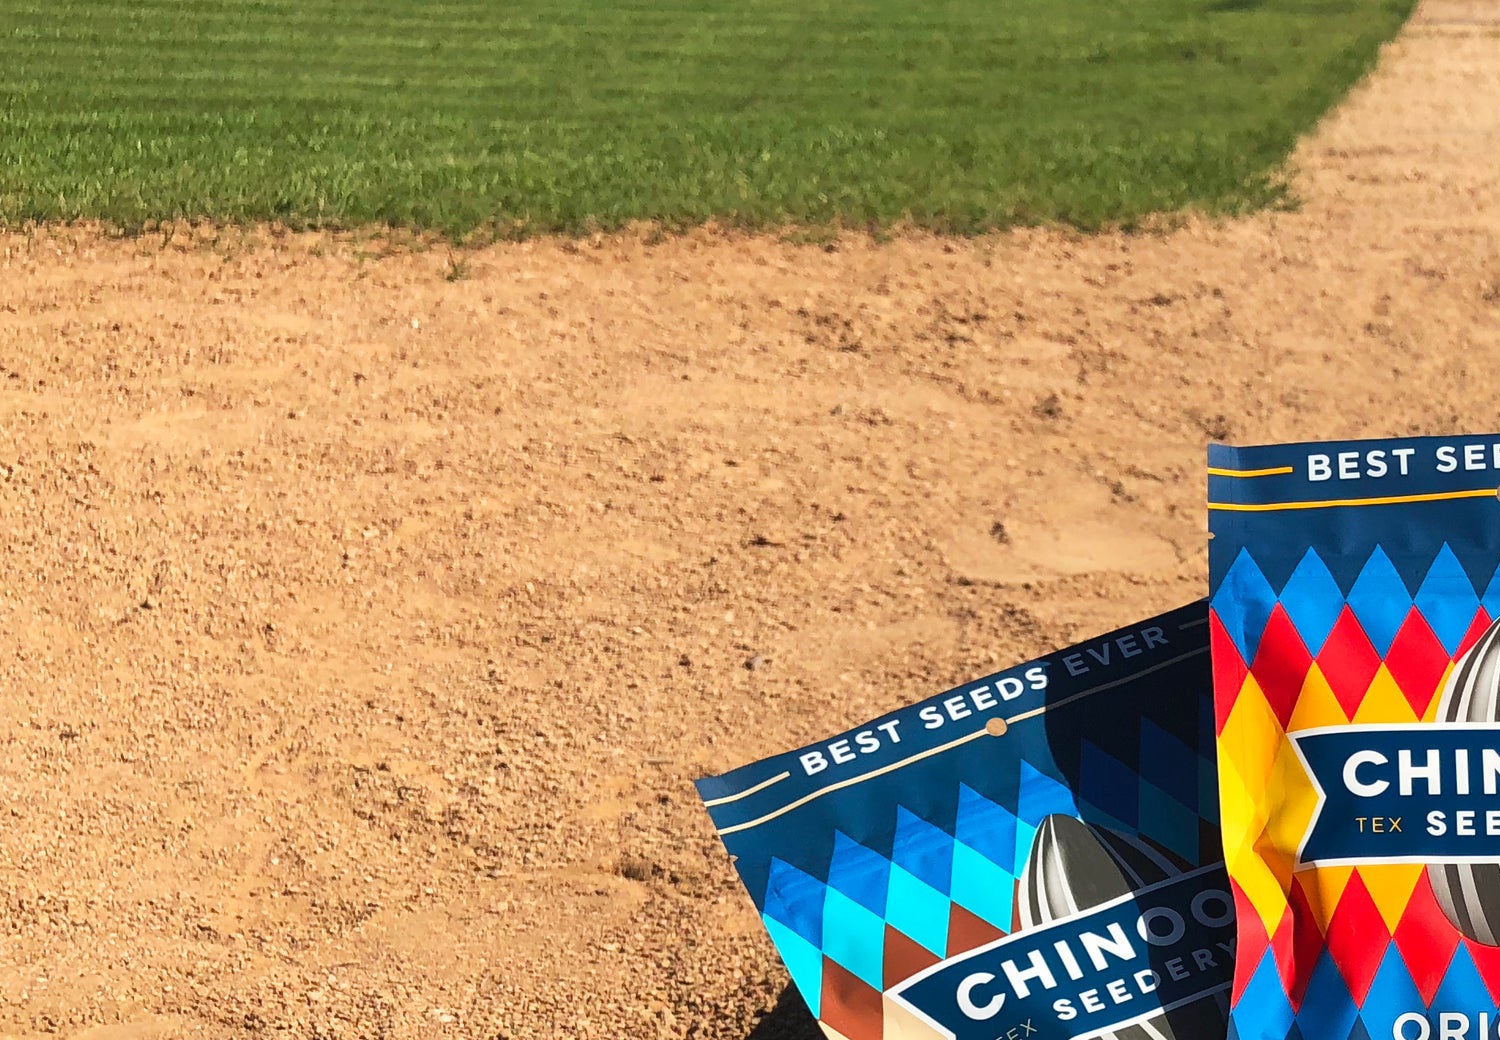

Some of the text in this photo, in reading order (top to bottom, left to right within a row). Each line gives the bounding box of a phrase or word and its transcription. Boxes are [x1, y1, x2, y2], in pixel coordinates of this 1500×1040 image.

[1307, 447, 1415, 482] BEST
[800, 626, 1170, 777] BEST SEEDS EVER
[1356, 816, 1402, 834] TEX
[956, 889, 1237, 1020] CHINOO
